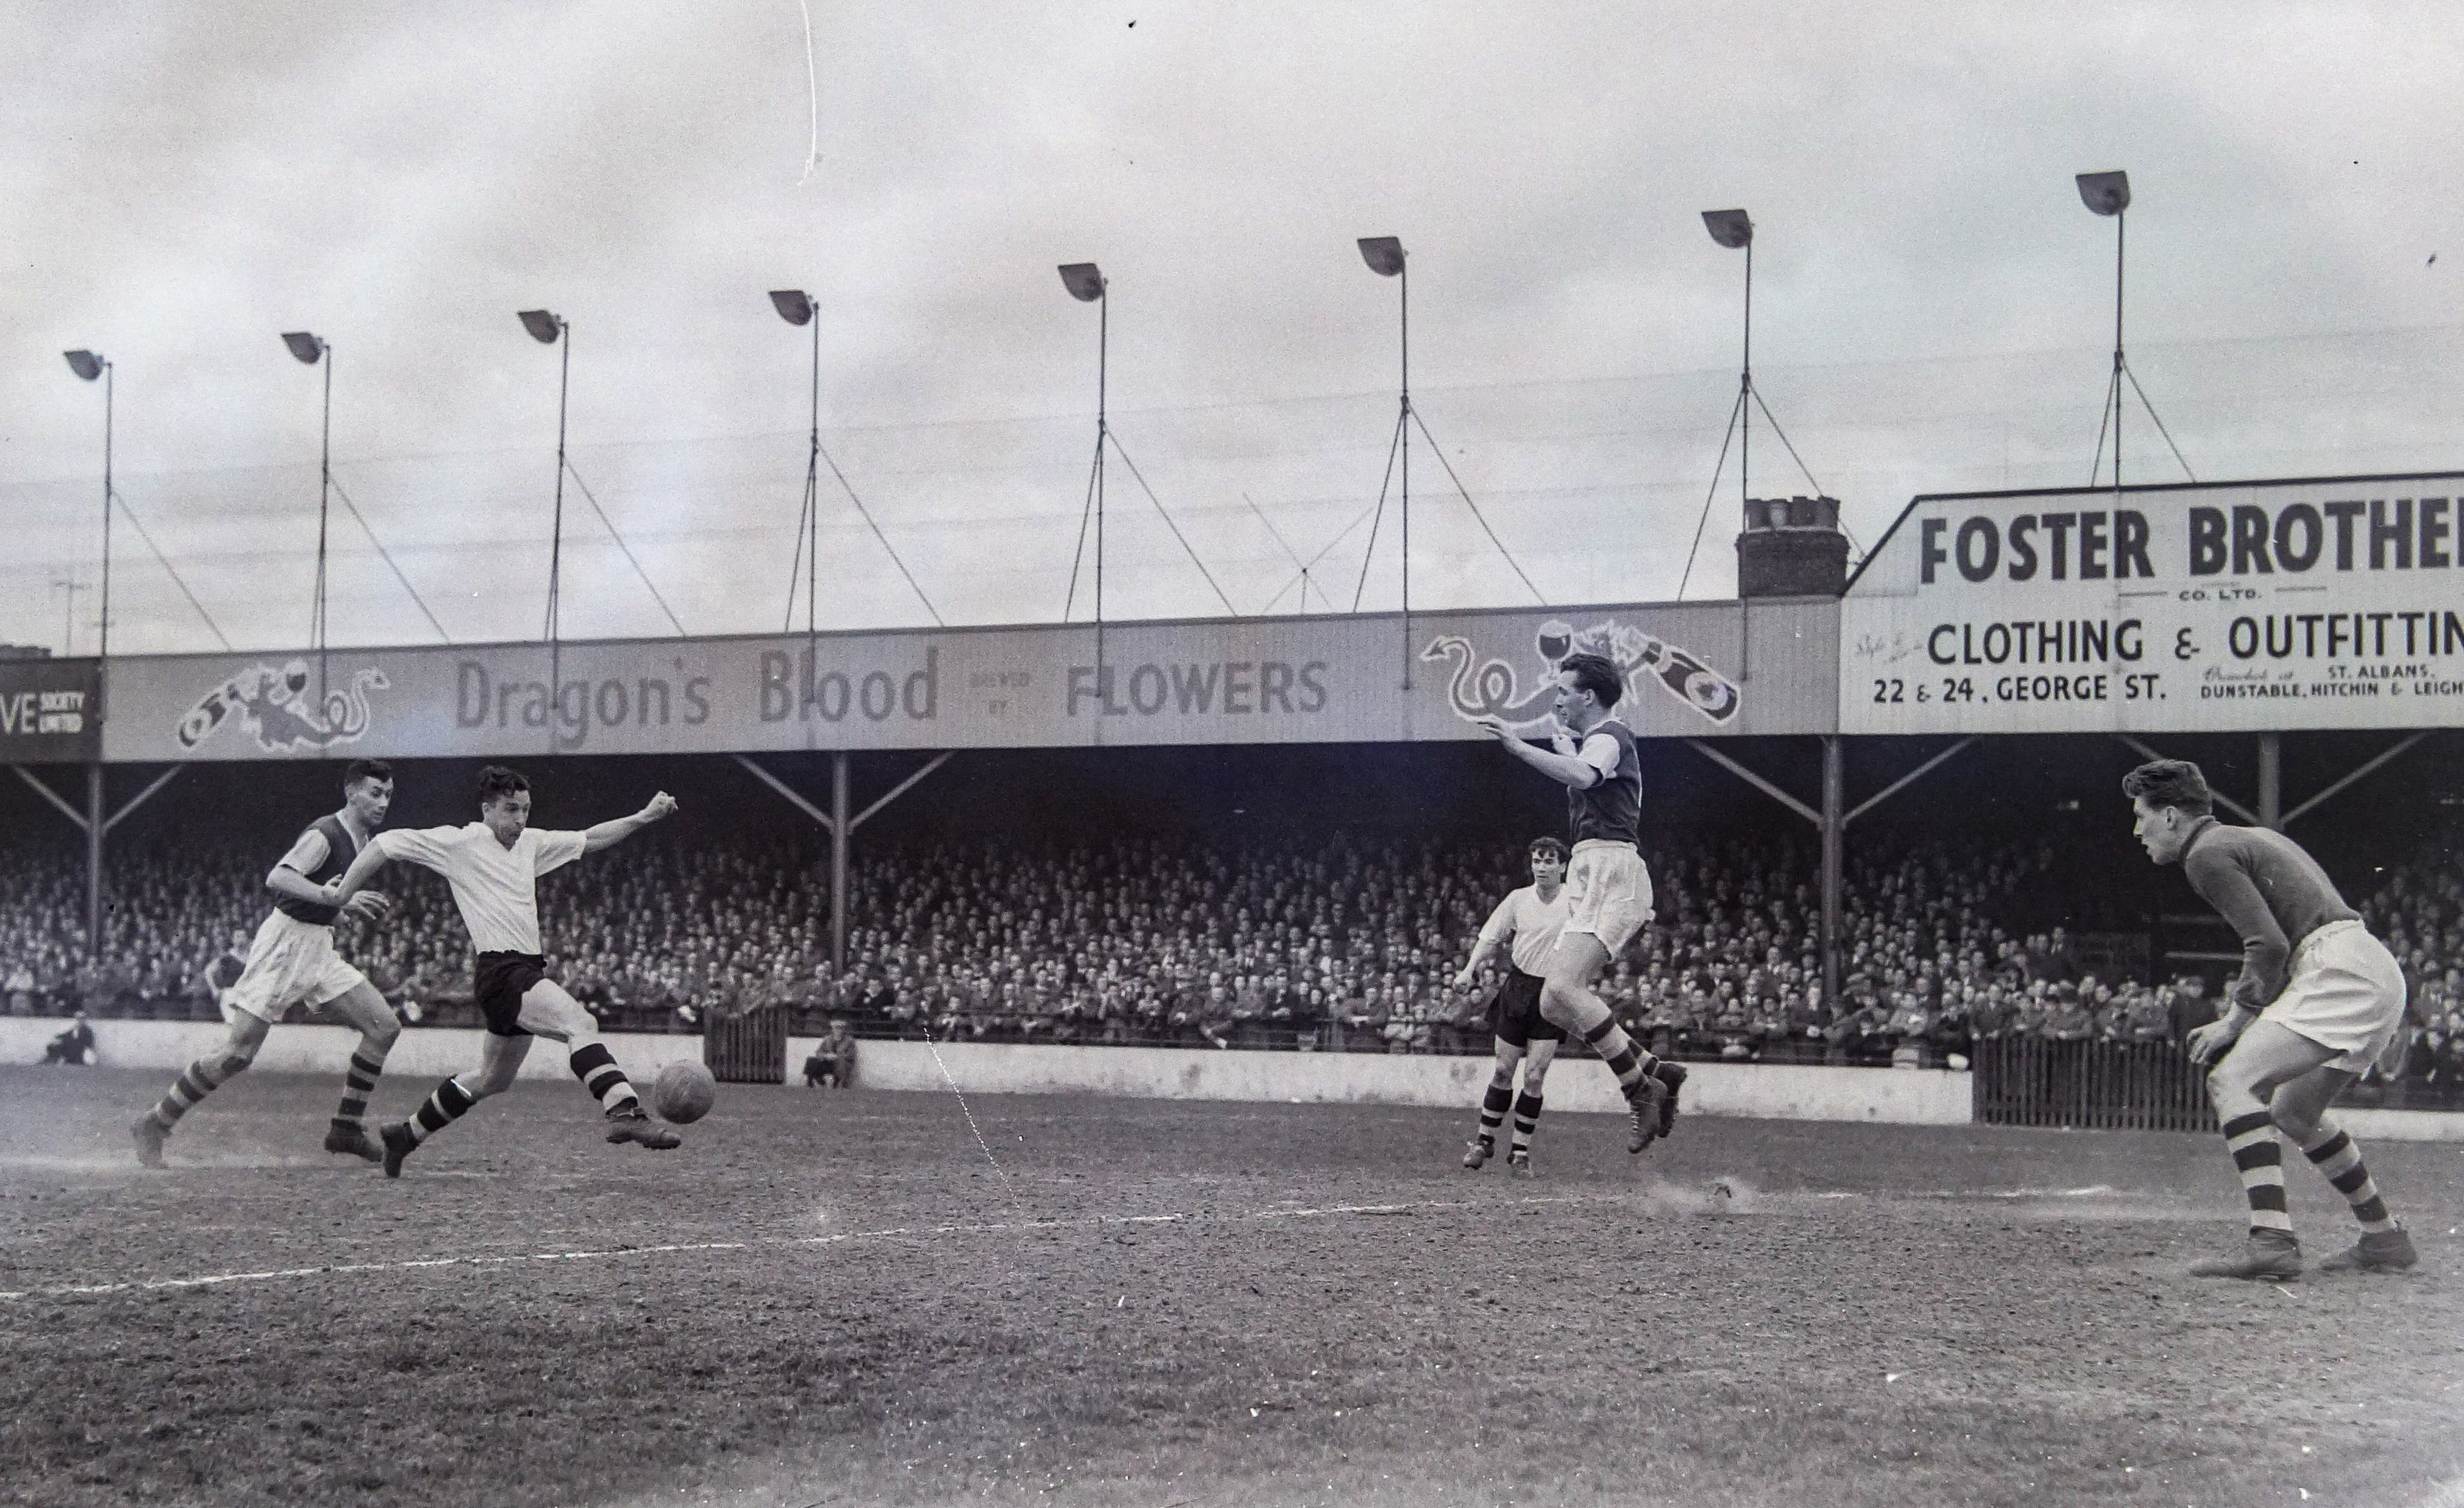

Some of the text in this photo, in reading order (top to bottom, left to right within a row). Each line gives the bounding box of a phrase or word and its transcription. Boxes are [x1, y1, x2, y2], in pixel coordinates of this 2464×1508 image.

[1920, 496, 2464, 585] FOSTER BROTHE
[1927, 619, 2143, 664] CLOTHING
[2174, 627, 2200, 660] &
[2229, 611, 2464, 660] OUTFITTIN
[455, 646, 939, 748] Dragon's Blood
[1066, 660, 1327, 717] FLOWERS
[1874, 678, 1904, 703] 22
[1917, 685, 1931, 703] &
[1997, 676, 2108, 701] GEORGE
[2125, 673, 2166, 700] ST.
[2311, 683, 2378, 696] HITCHIN
